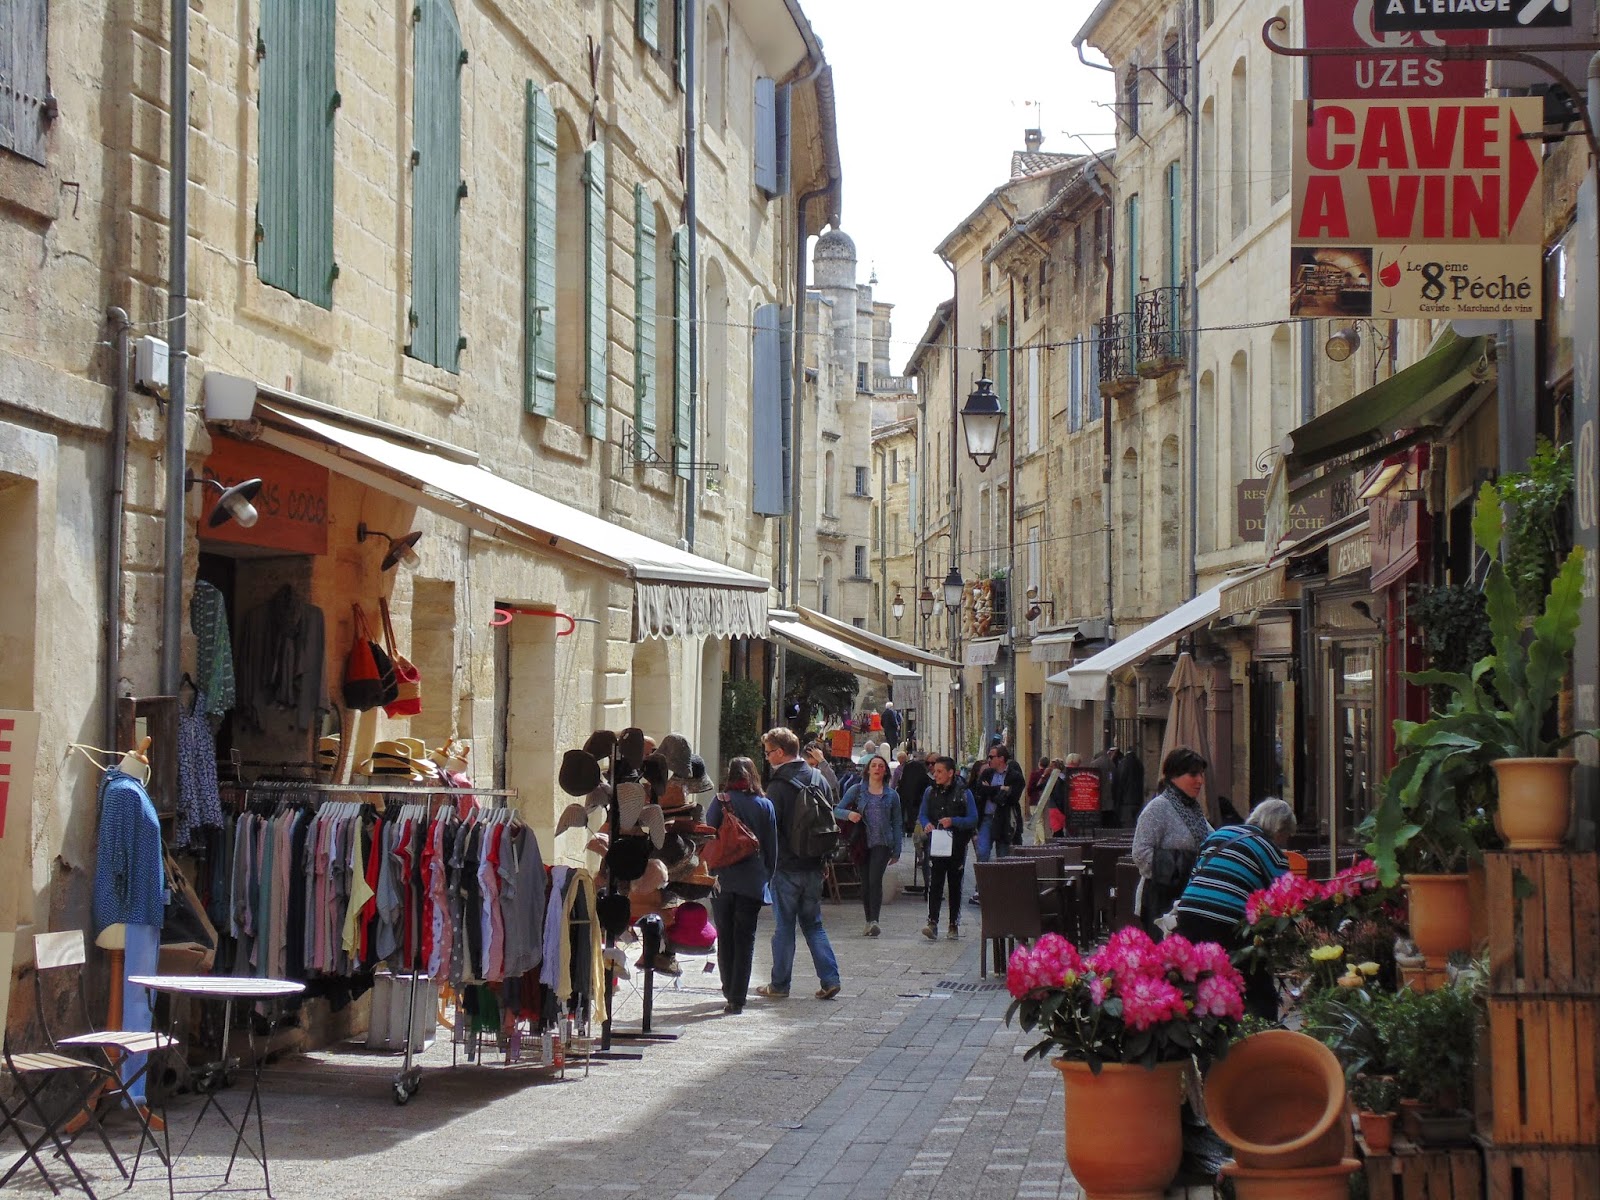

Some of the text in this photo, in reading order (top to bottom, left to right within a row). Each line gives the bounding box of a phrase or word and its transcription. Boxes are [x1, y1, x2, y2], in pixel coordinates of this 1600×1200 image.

[1356, 59, 1444, 88] UZES
[1307, 106, 1500, 170] CAVE
[1298, 175, 1500, 238] A VIN
[1407, 262, 1421, 272] Le
[1450, 274, 1531, 300] Péché
[1419, 303, 1450, 312] Caviste
[1457, 304, 1500, 312] Marchand
[1502, 304, 1512, 312] de
[1515, 304, 1533, 312] vins
